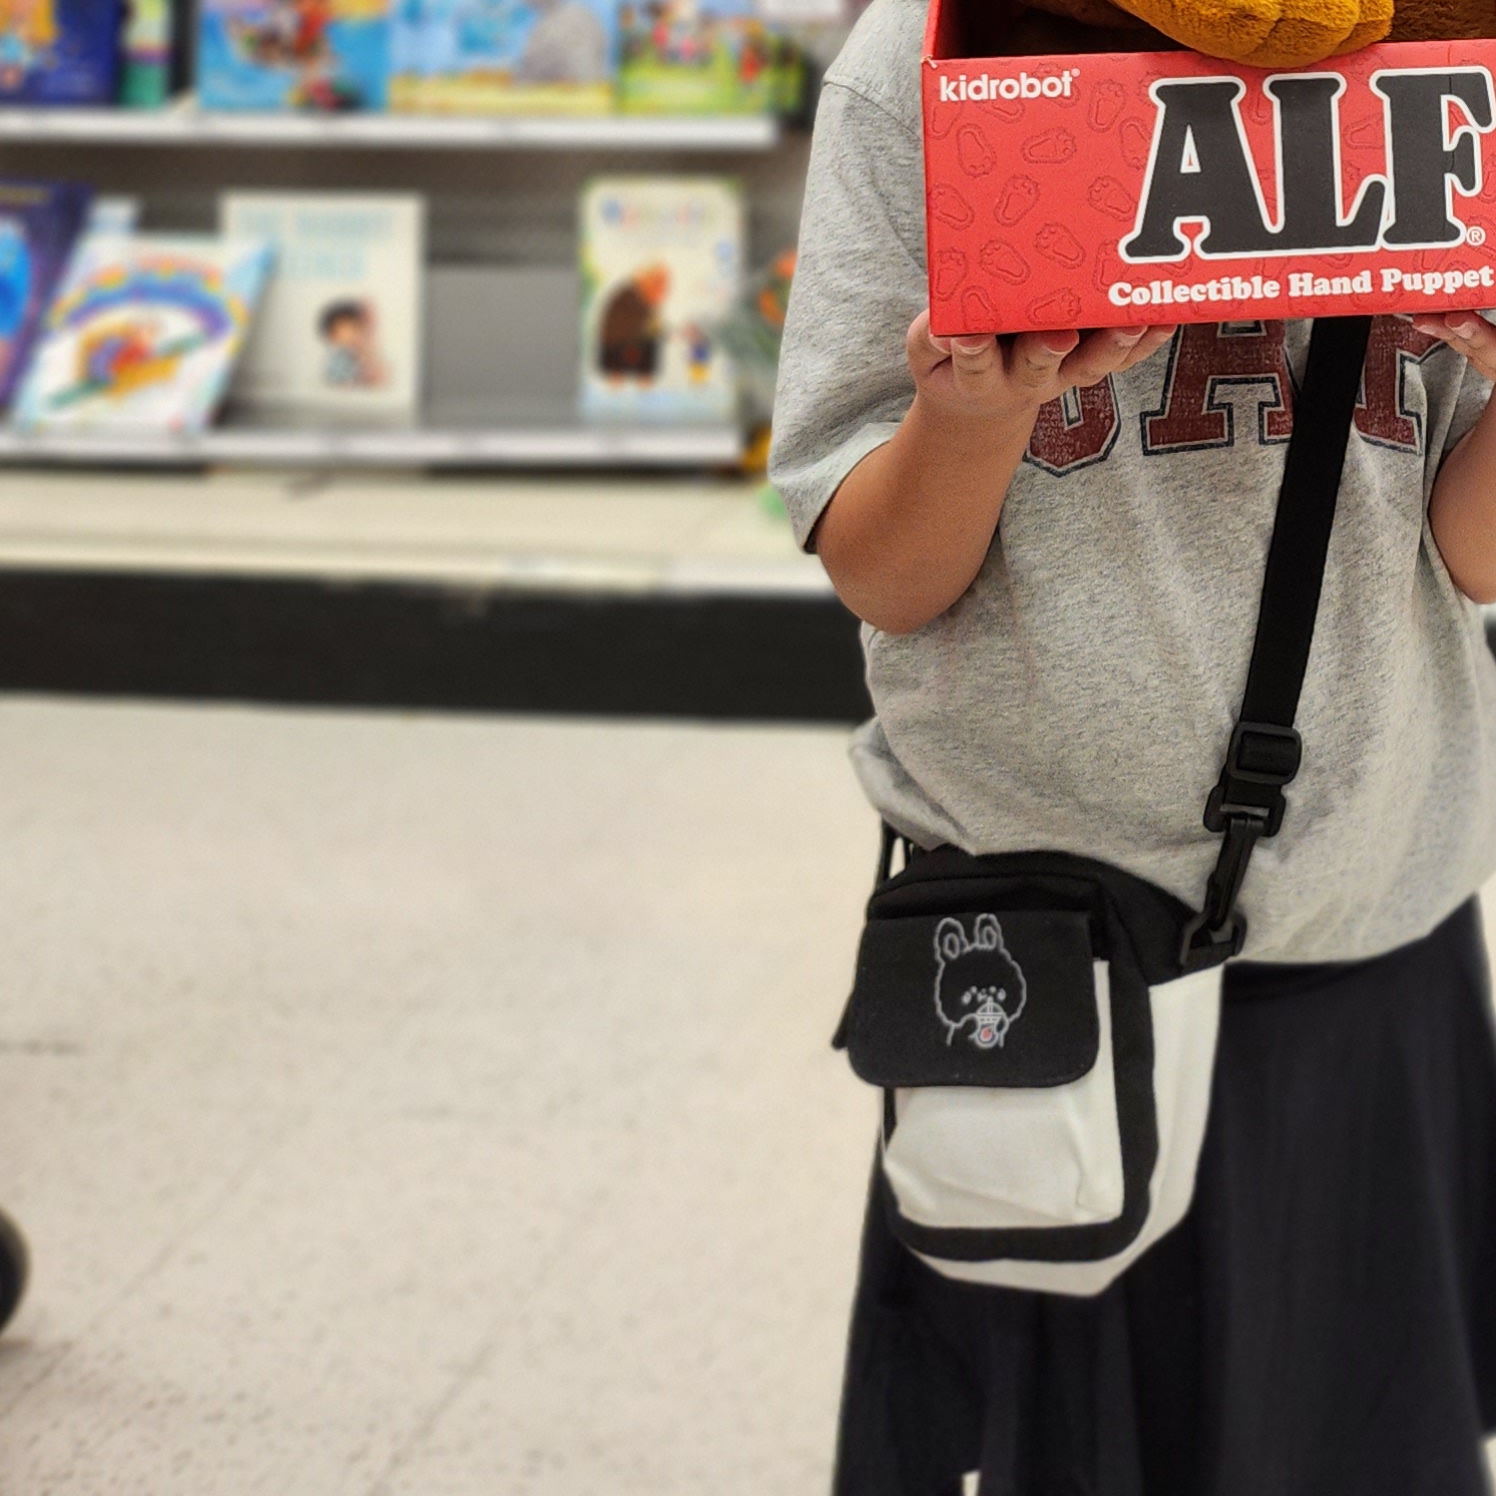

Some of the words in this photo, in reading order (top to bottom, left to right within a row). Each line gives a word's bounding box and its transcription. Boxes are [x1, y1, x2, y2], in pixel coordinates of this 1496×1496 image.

[1107, 276, 1281, 306] Collectible
[1288, 270, 1373, 297] Hand
[1381, 264, 1495, 294] Puppet
